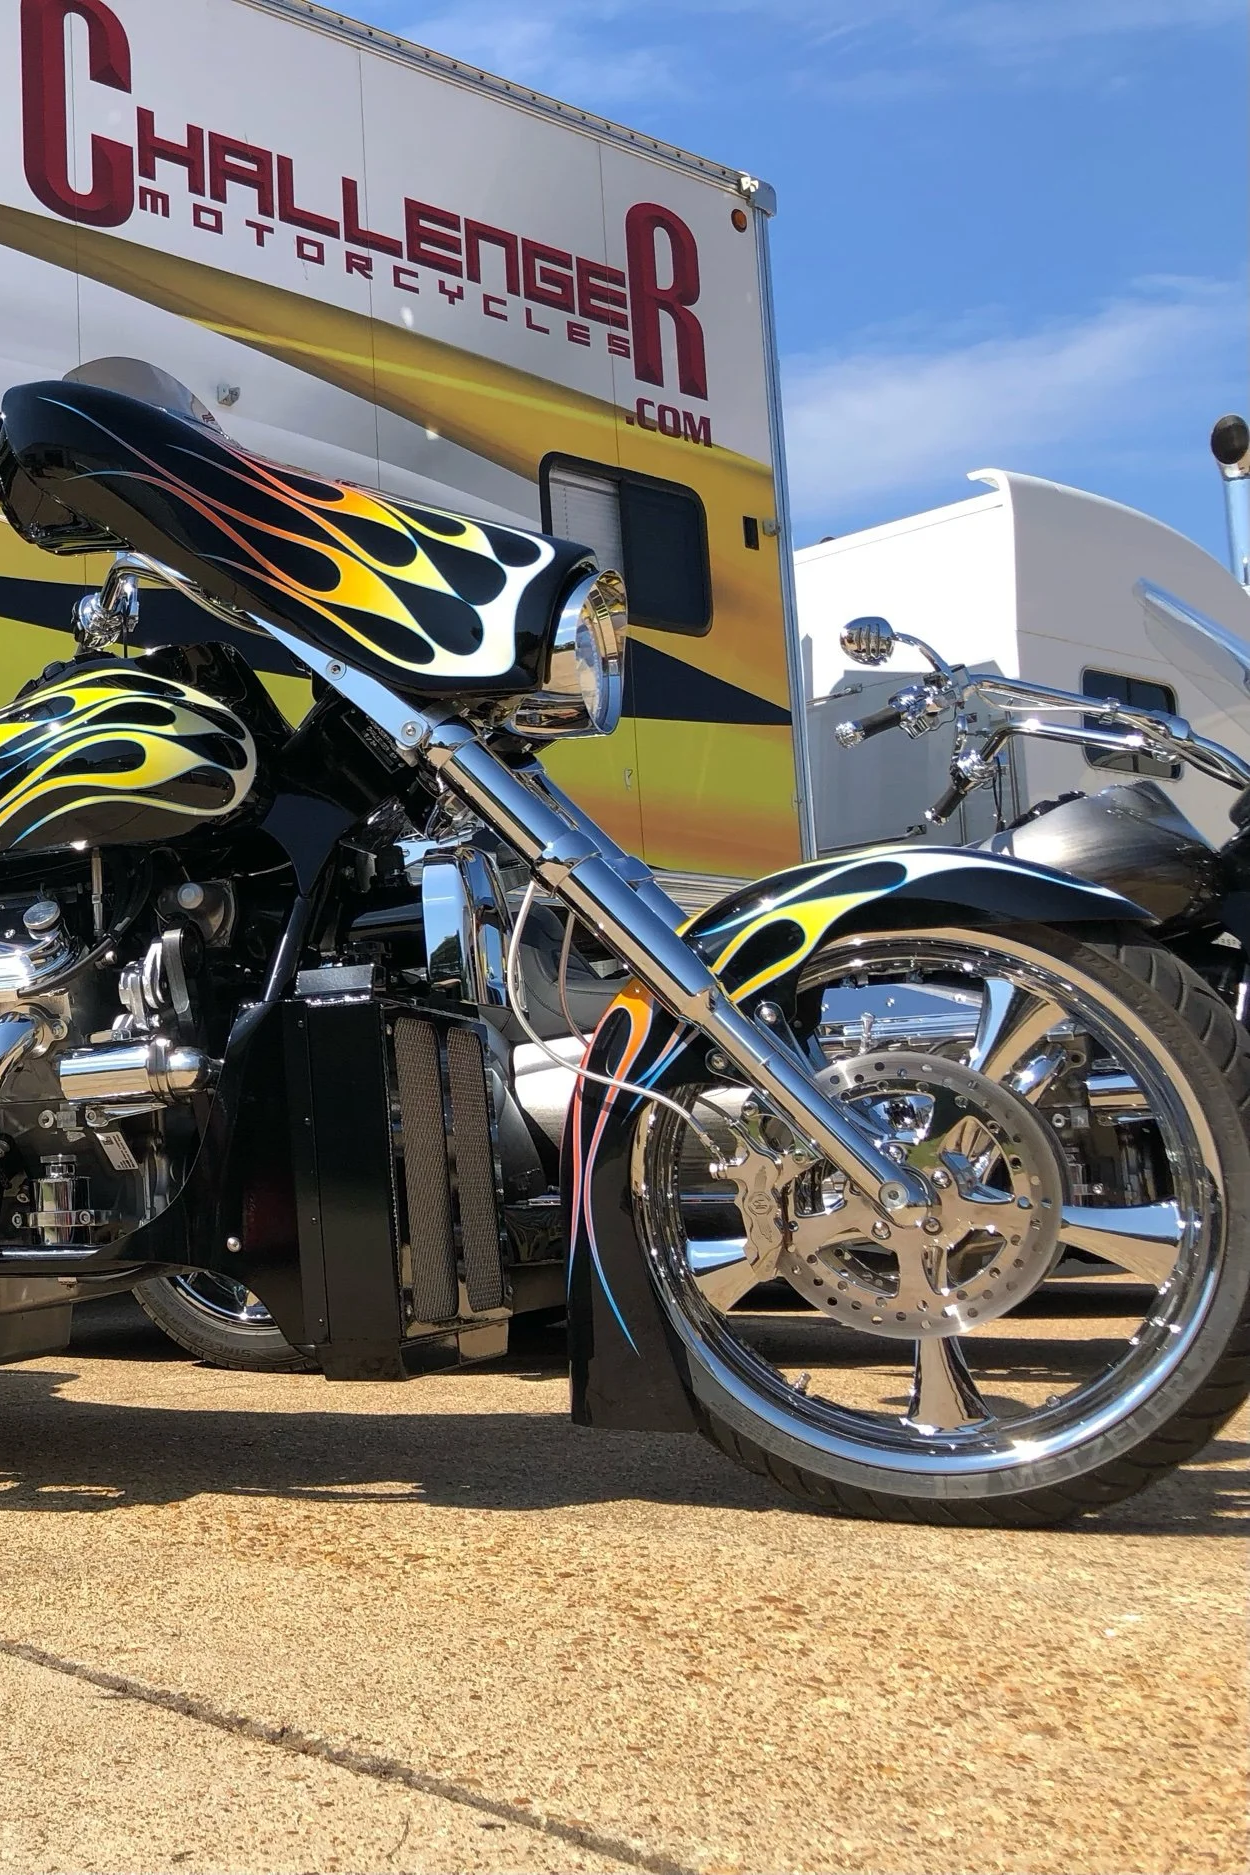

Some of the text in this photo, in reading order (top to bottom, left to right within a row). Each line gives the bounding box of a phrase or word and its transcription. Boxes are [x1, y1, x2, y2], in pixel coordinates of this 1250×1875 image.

[21, 0, 708, 401] CHALLENGER
[139, 186, 631, 359] MOTORCYCLES
[625, 397, 713, 448] .COM
